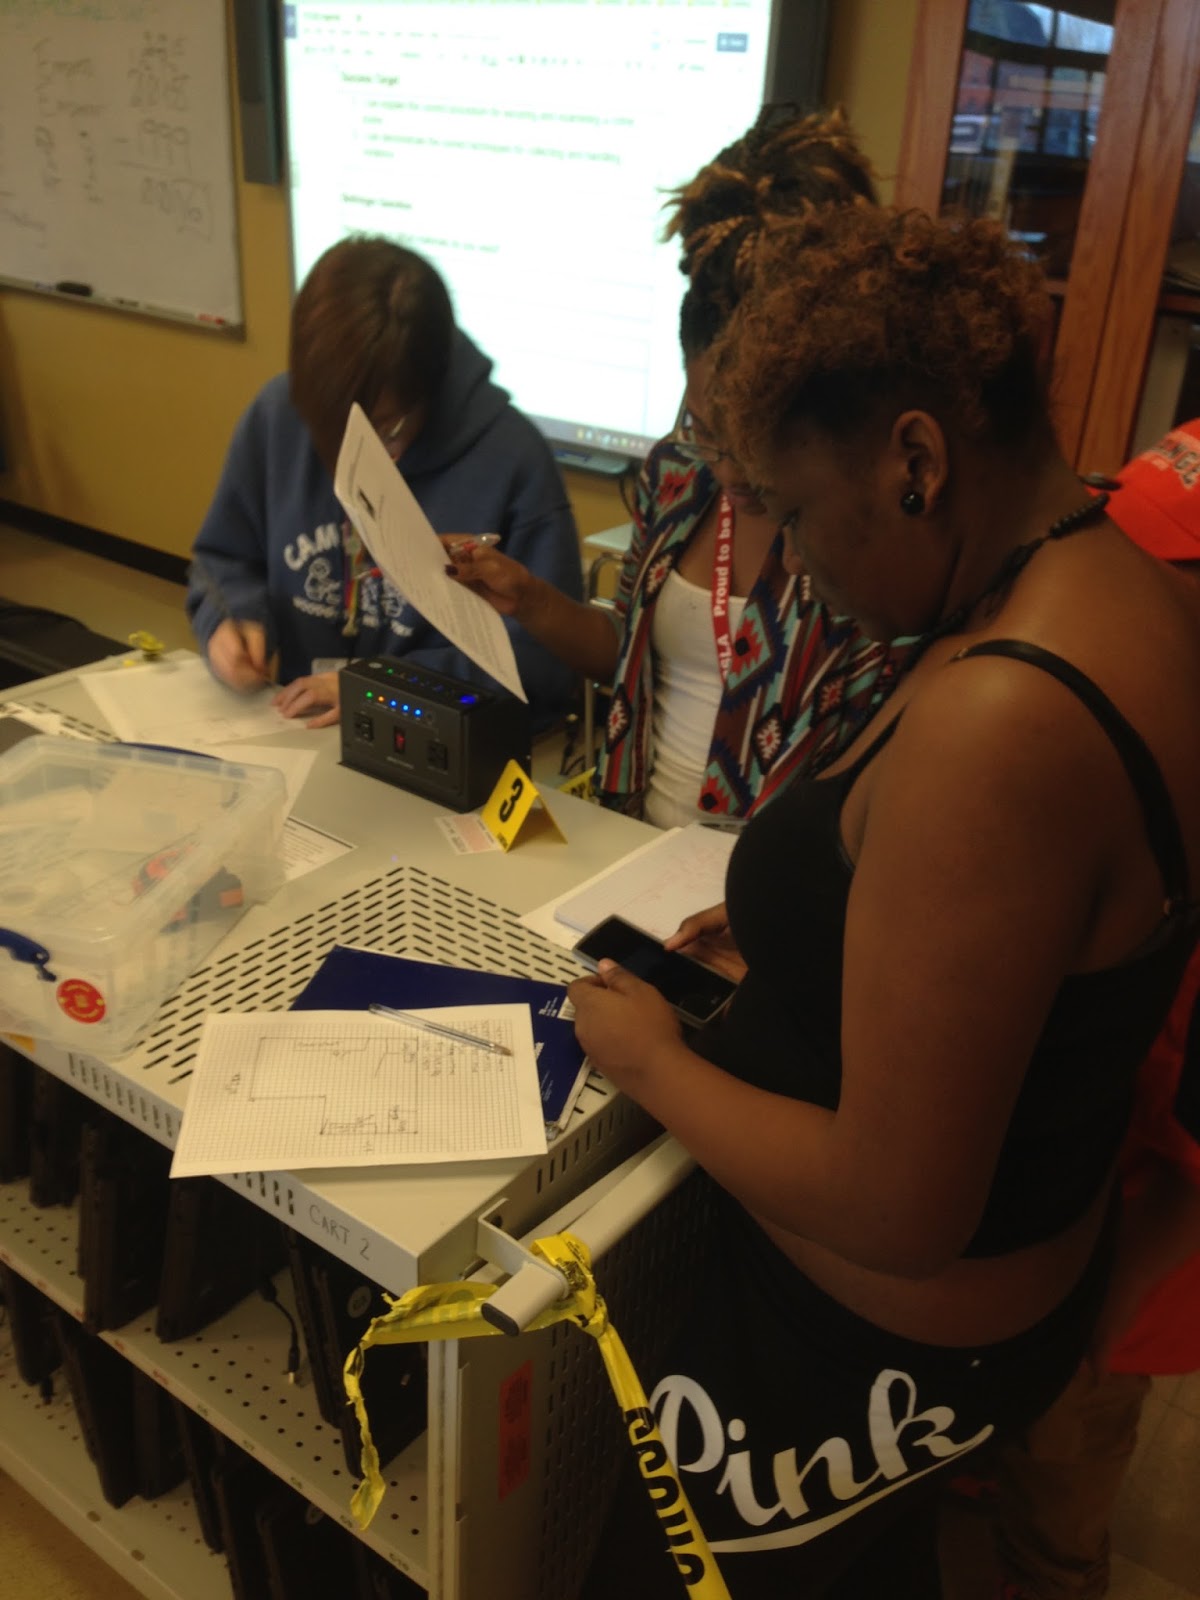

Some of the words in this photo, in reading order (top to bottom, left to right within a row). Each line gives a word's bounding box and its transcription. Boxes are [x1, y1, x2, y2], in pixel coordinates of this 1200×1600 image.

[718, 516, 731, 539] be
[717, 544, 730, 562] to
[713, 566, 729, 618] Proud
[498, 777, 524, 823] 3
[309, 1204, 350, 1245] CART
[360, 1238, 370, 1261] 2
[650, 1368, 995, 1527] Pink
